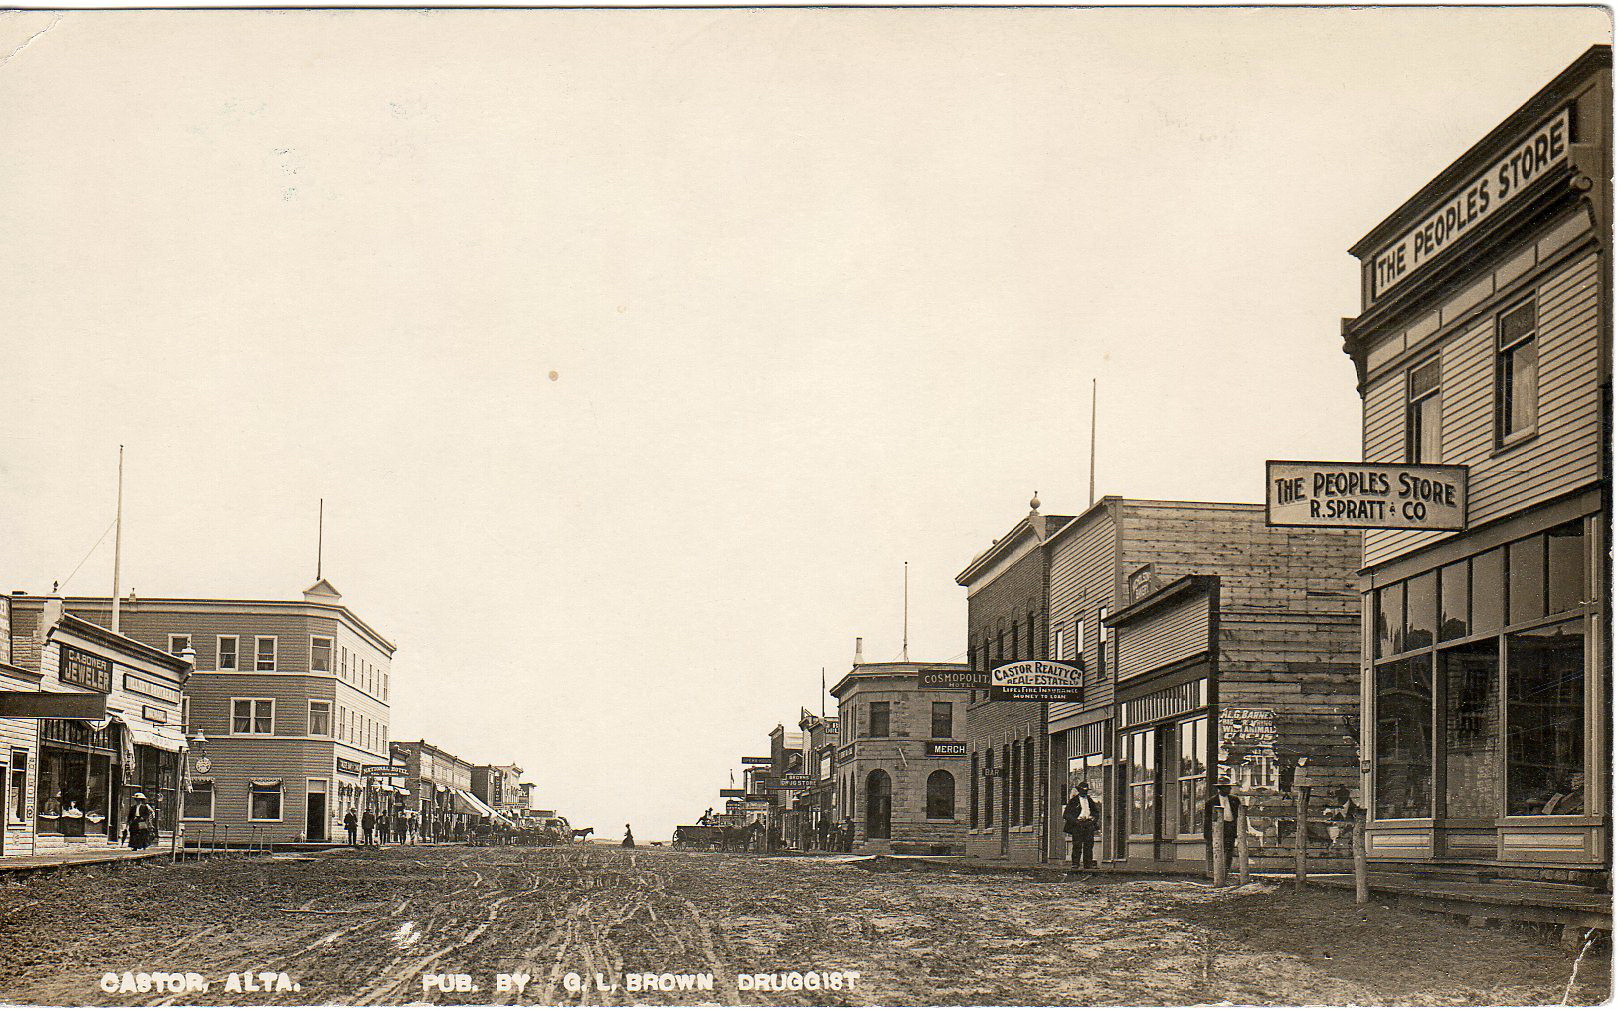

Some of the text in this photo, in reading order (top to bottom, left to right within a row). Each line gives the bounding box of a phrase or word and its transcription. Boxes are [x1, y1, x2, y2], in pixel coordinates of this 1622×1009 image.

[1378, 117, 1564, 287] THE PEOPLES STORE
[1274, 471, 1457, 508] THE PEOPLES STORE
[1402, 501, 1428, 522] CO
[65, 661, 109, 691] JEWELER
[924, 673, 991, 684] COSMOPOLIT
[994, 664, 1033, 681] CASTOR
[1035, 661, 1071, 678] REALTY
[1244, 726, 1277, 734] ANIMAL
[934, 745, 966, 754] MERCH
[363, 766, 390, 774] NATIONAL
[984, 768, 1000, 776] BAR
